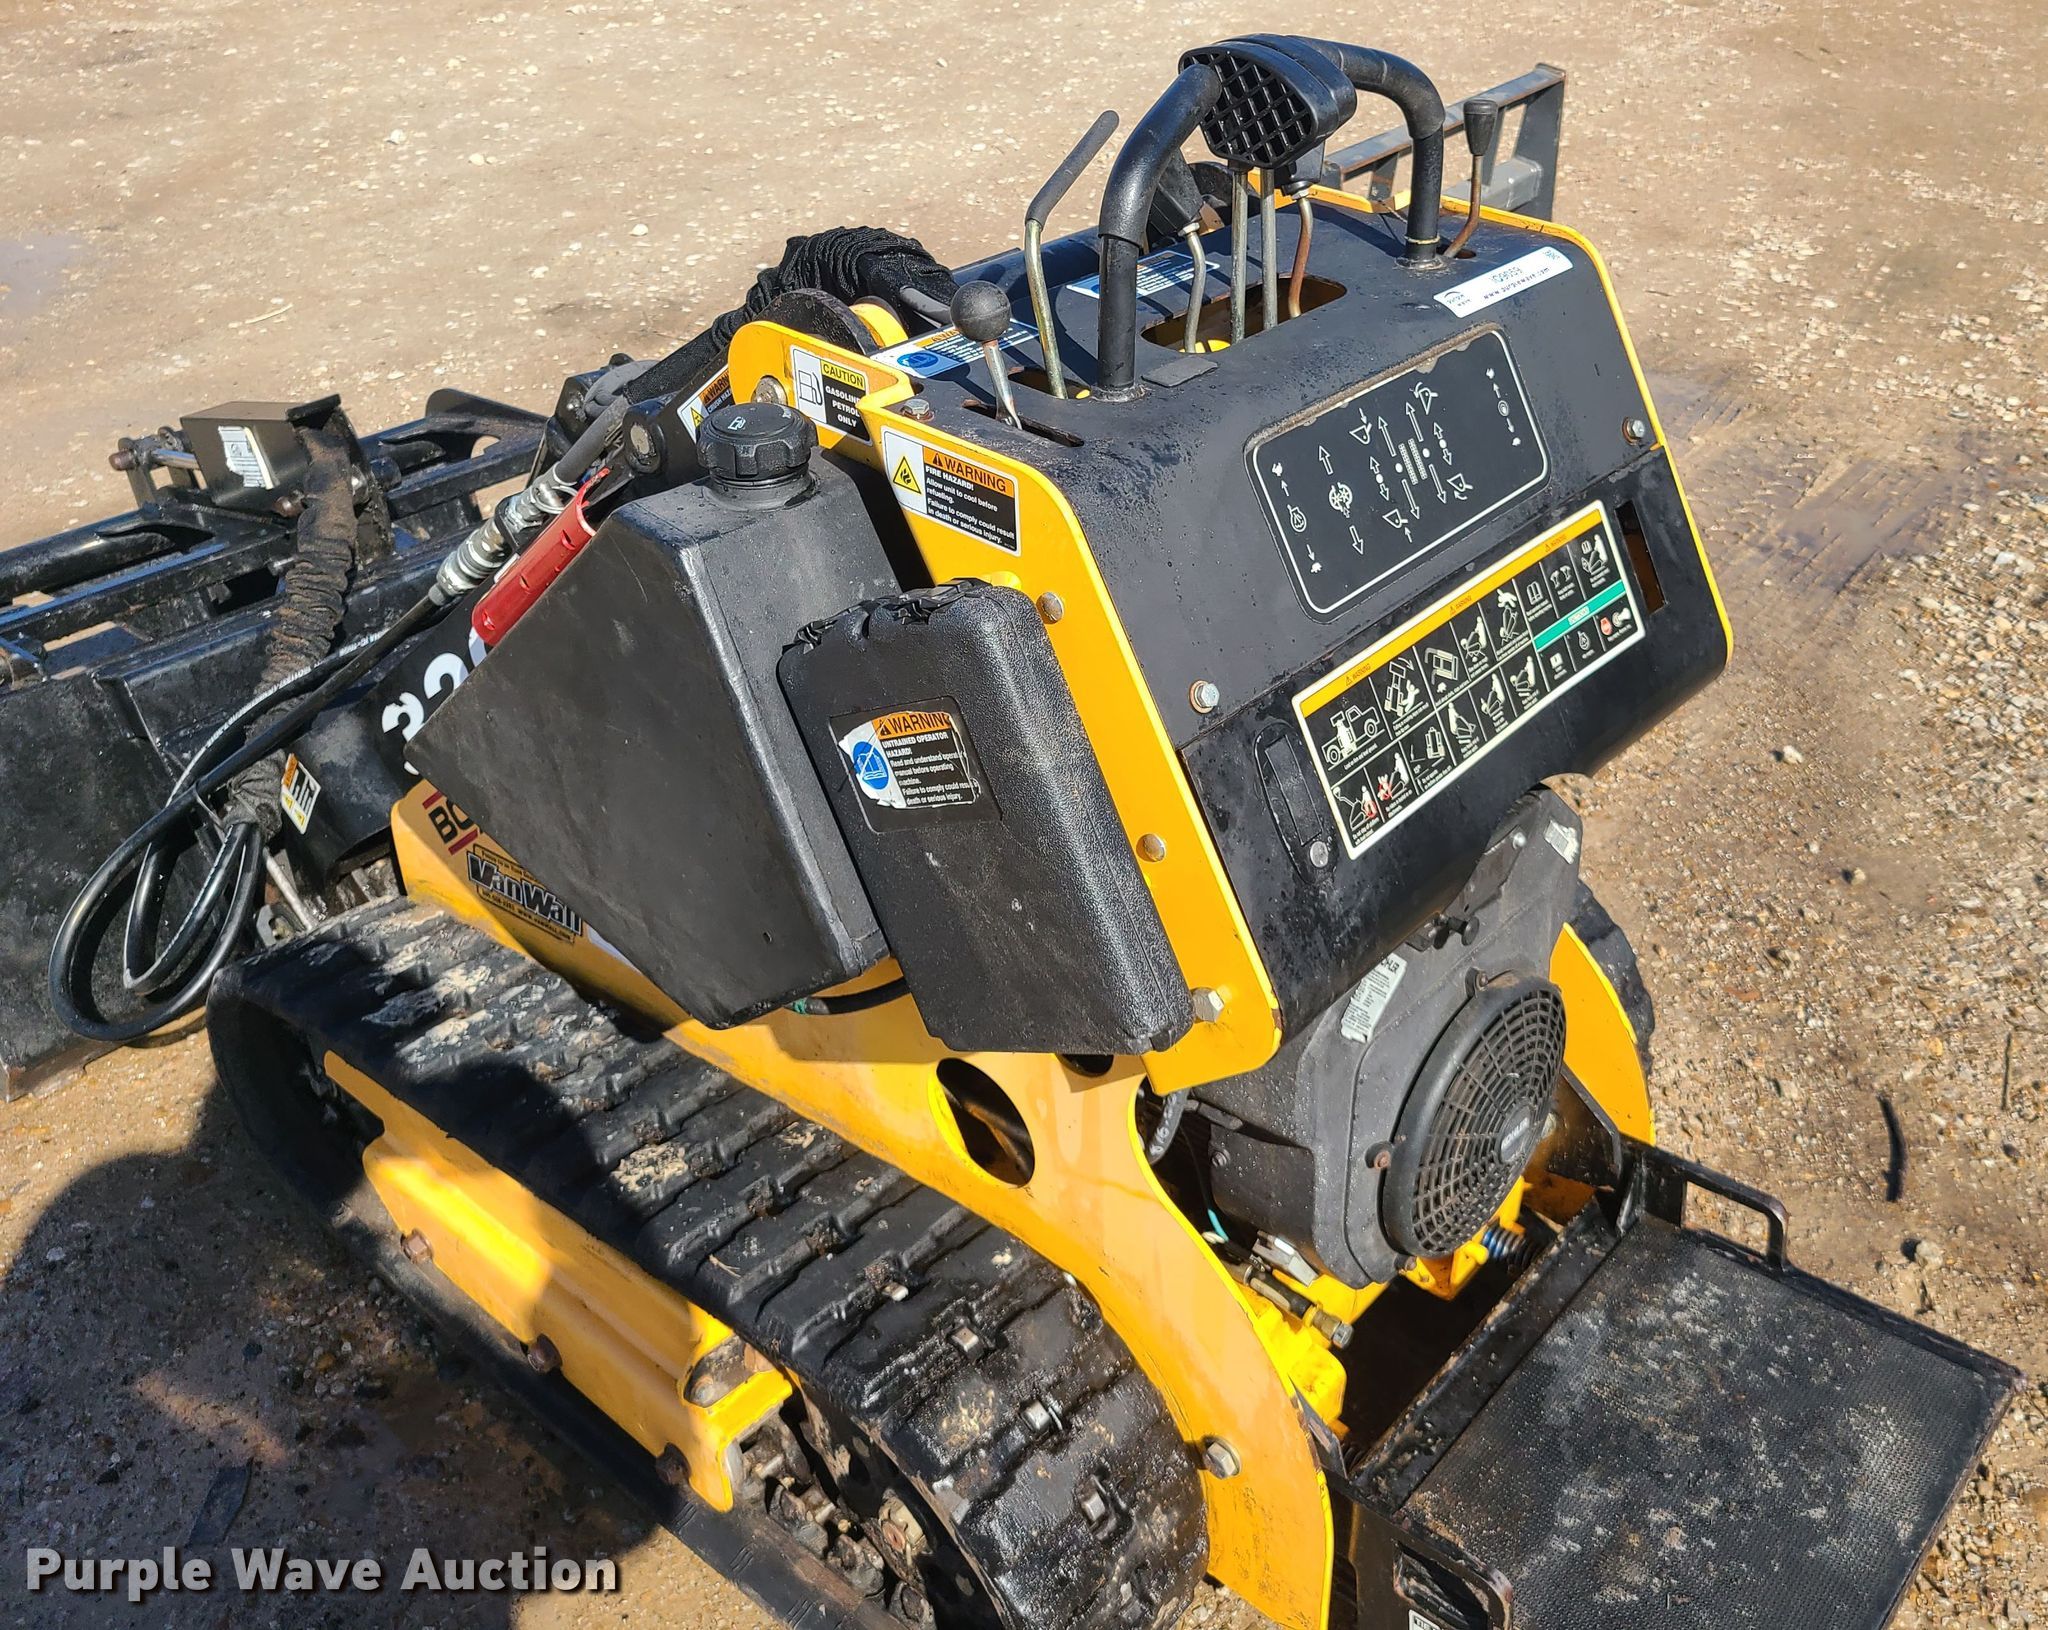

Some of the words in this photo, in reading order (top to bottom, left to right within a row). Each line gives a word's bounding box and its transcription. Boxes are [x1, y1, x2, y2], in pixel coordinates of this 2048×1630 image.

[823, 363, 864, 387] CAUTION
[832, 400, 860, 417] PETROL
[837, 414, 857, 427] ONLY
[926, 465, 942, 478] FIRE
[942, 471, 974, 491] HAZARD!
[944, 456, 1006, 493] WARNING
[926, 477, 943, 490] Allow
[943, 484, 956, 495] unit
[956, 488, 963, 498] to
[963, 492, 978, 503] cool
[978, 497, 998, 512] before
[927, 497, 948, 512] Failure
[948, 506, 955, 515] to
[955, 510, 978, 525] comply
[978, 519, 996, 532] could
[996, 527, 1015, 540] result
[935, 509, 952, 522] death
[952, 517, 960, 525] or
[960, 520, 983, 535] serious
[881, 736, 916, 749] UNTRAINED
[916, 731, 949, 743] OPERATOR
[467, 851, 583, 936] VanWall
